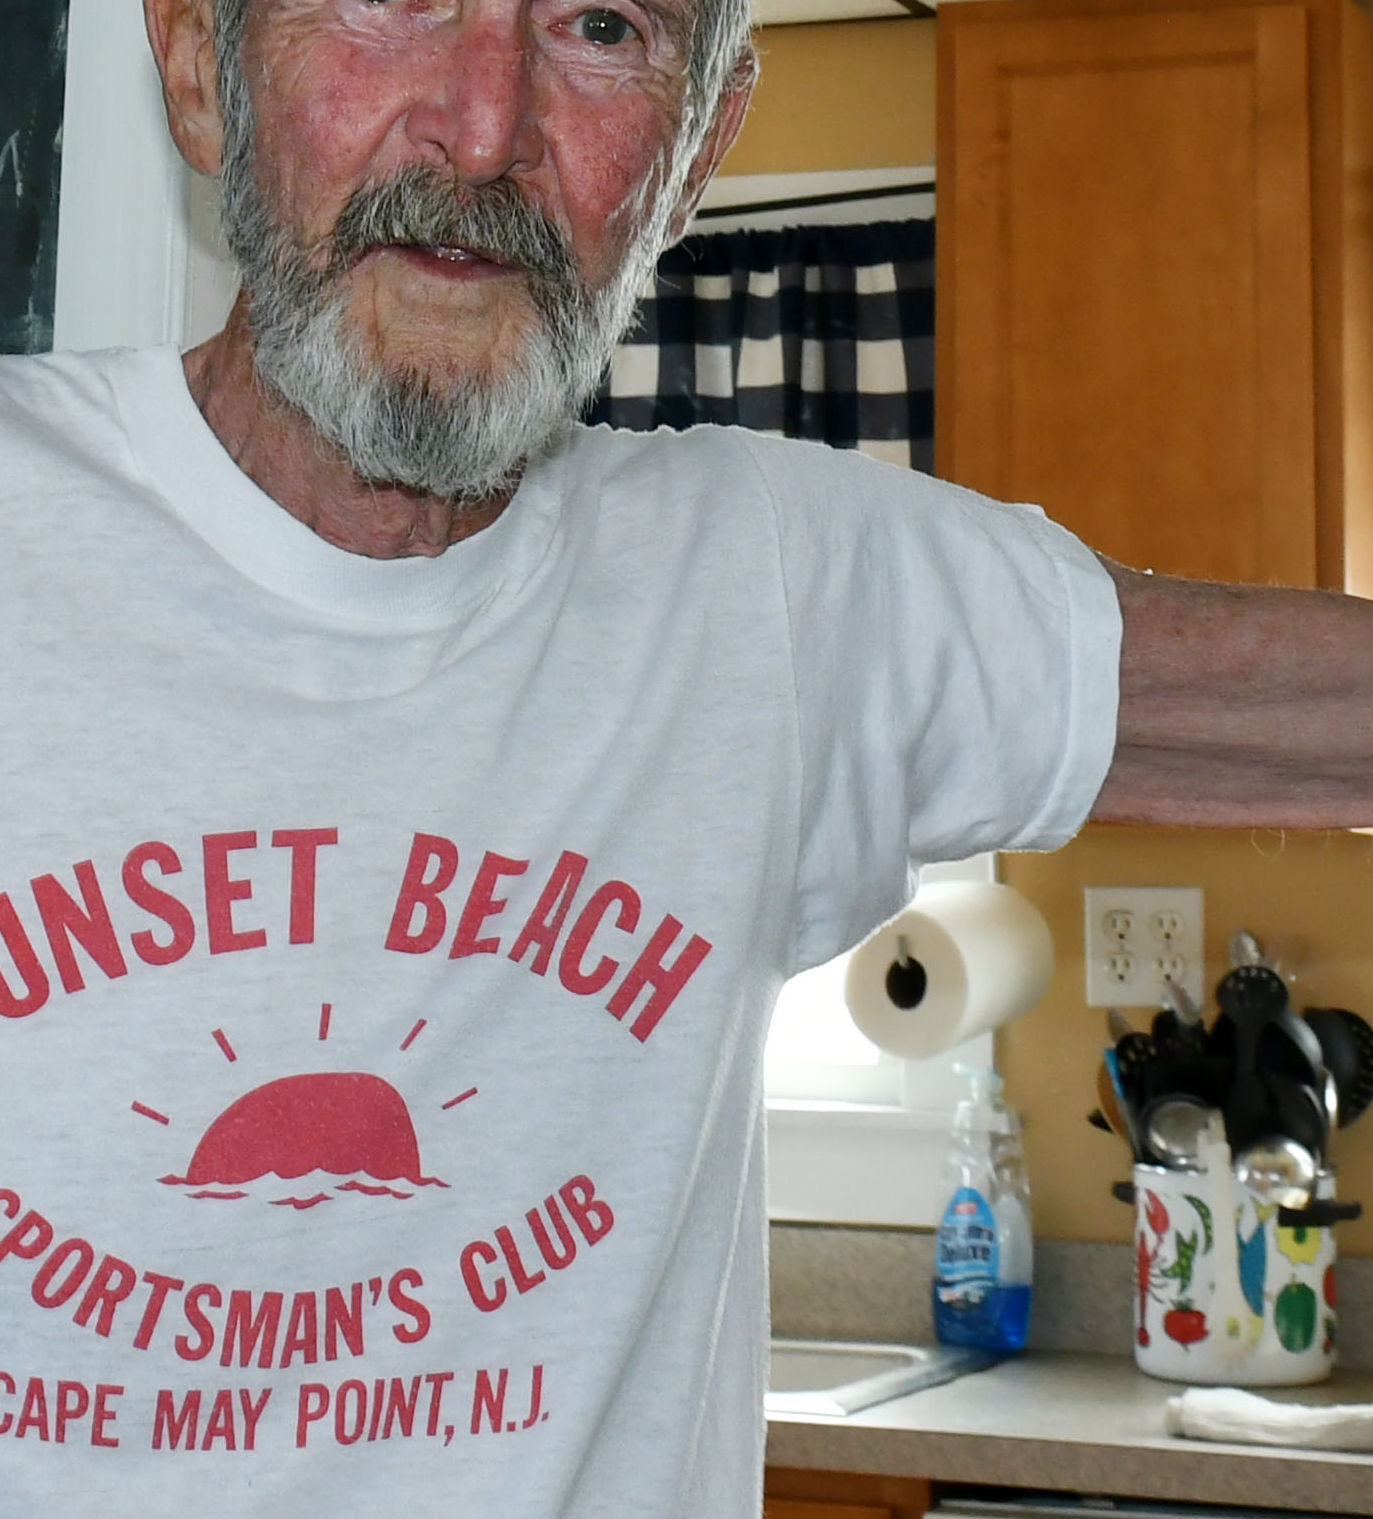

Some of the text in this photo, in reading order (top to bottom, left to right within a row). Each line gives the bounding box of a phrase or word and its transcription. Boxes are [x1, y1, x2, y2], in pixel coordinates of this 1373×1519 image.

[384, 832, 712, 1043] BEACH
[458, 1174, 615, 1312] CLUB
[151, 1387, 272, 1451] MAY
[296, 1372, 455, 1448] POINT,
[470, 1364, 551, 1434] N.J.
